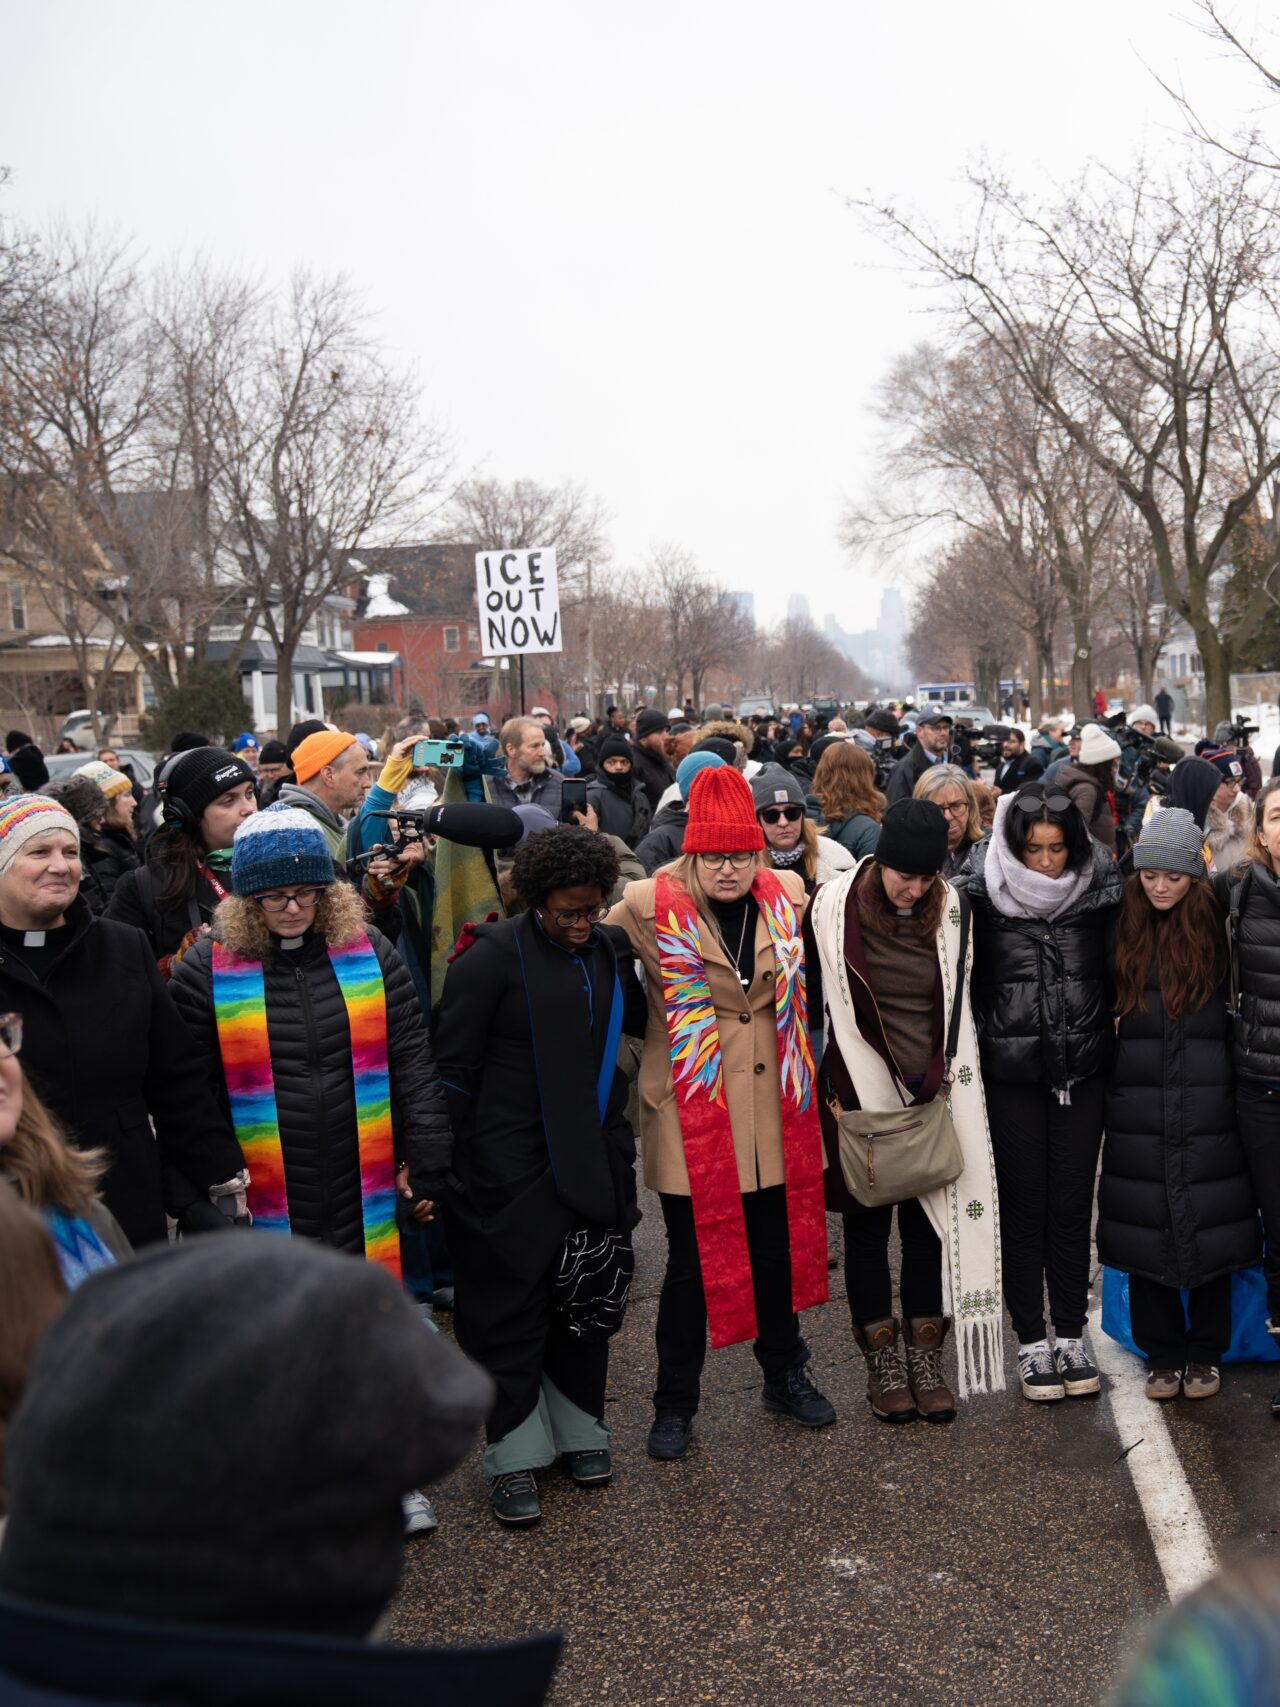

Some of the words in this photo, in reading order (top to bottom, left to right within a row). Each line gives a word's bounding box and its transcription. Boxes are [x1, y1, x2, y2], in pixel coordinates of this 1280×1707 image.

[484, 552, 544, 588] ICE
[486, 588, 544, 613] OUT
[488, 611, 557, 649] NOW
